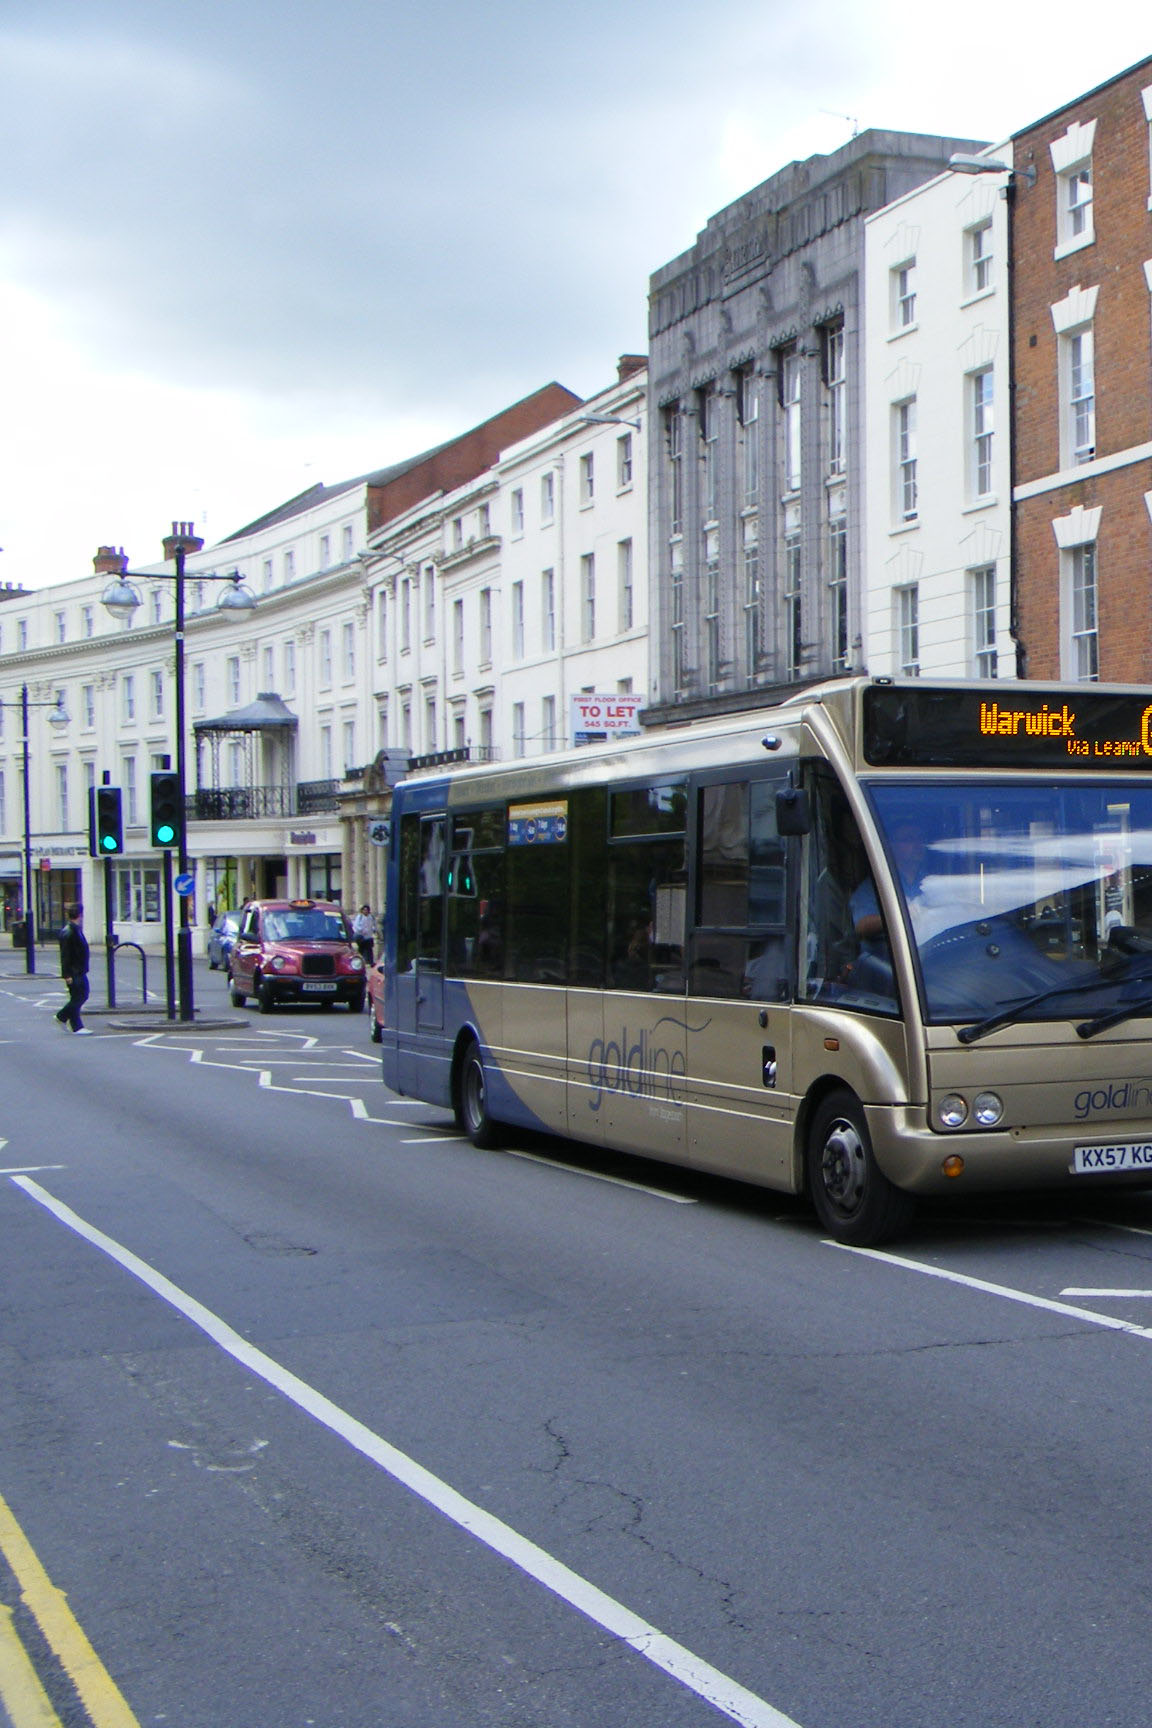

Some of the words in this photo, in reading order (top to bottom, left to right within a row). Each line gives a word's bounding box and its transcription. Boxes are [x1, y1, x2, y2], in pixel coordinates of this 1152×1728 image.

[579, 706, 601, 717] TO
[607, 706, 636, 717] LET
[980, 702, 1075, 736] Warwick
[588, 1026, 686, 1112] goldline
[1082, 1146, 1126, 1168] KX57
